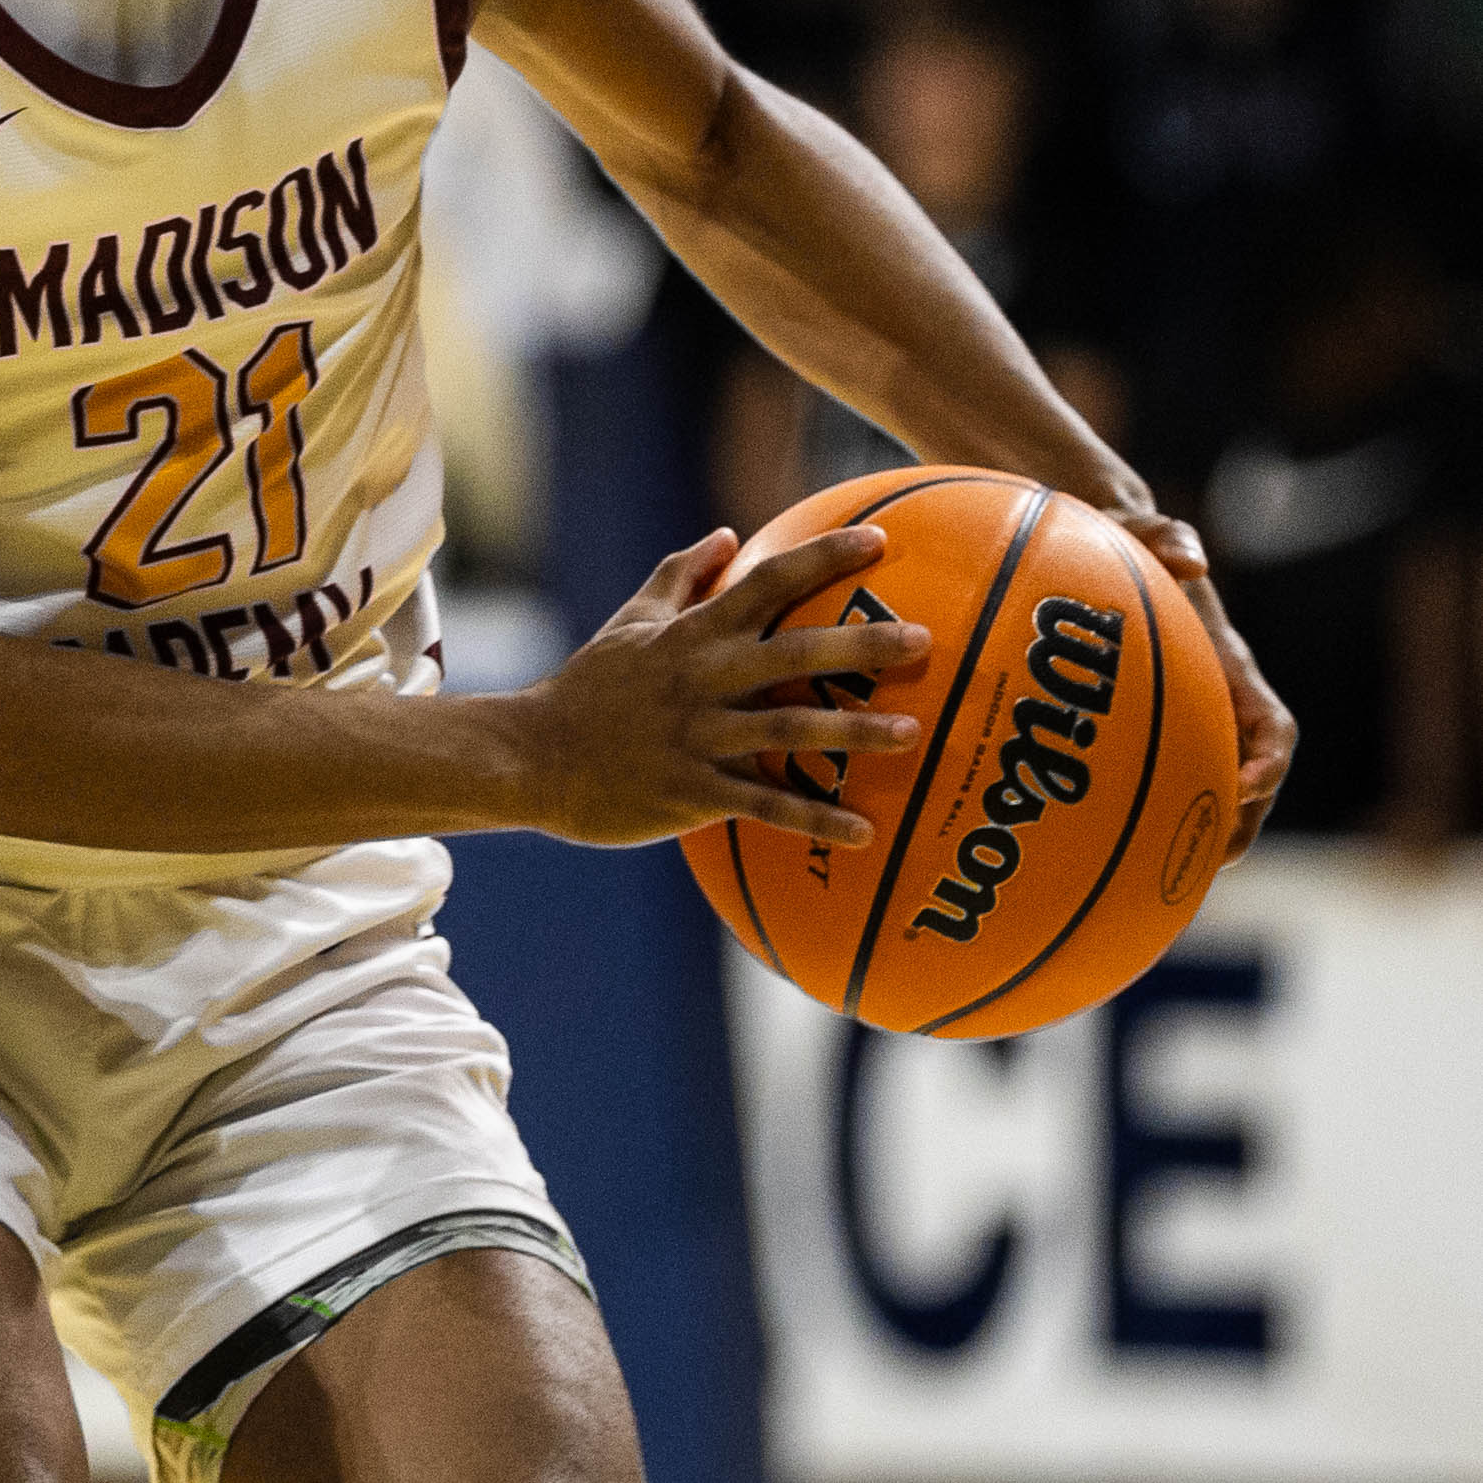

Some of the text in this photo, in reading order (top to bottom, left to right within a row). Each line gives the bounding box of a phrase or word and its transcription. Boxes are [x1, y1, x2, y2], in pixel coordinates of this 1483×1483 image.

[70, 320, 319, 611] 21
[807, 837, 833, 890] XT
[912, 596, 1125, 943] Wilson
